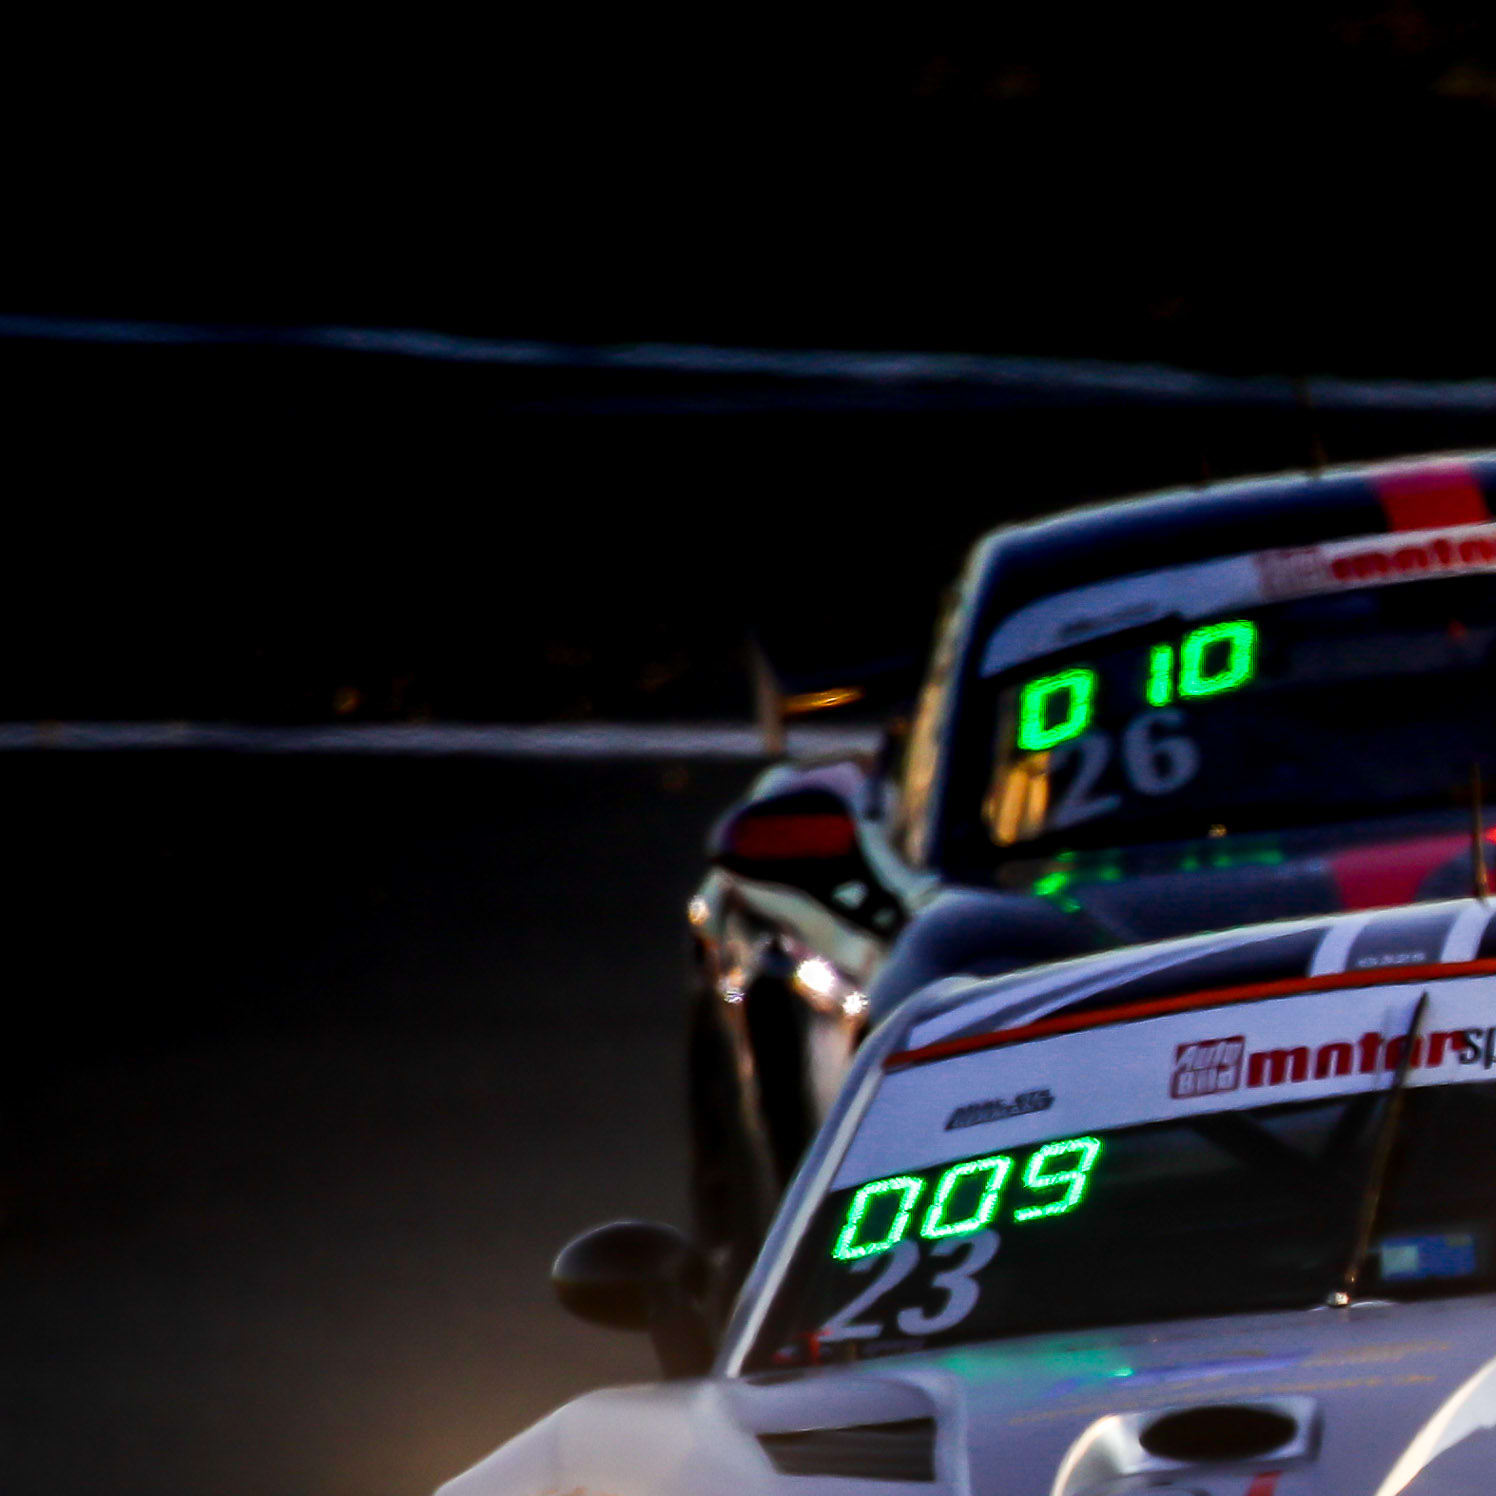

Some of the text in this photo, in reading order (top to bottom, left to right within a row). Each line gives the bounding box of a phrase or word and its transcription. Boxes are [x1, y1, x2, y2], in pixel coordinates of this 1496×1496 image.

[1052, 708, 1198, 818] 26
[832, 1135, 1101, 1262] 009
[820, 1231, 1001, 1342] 23
